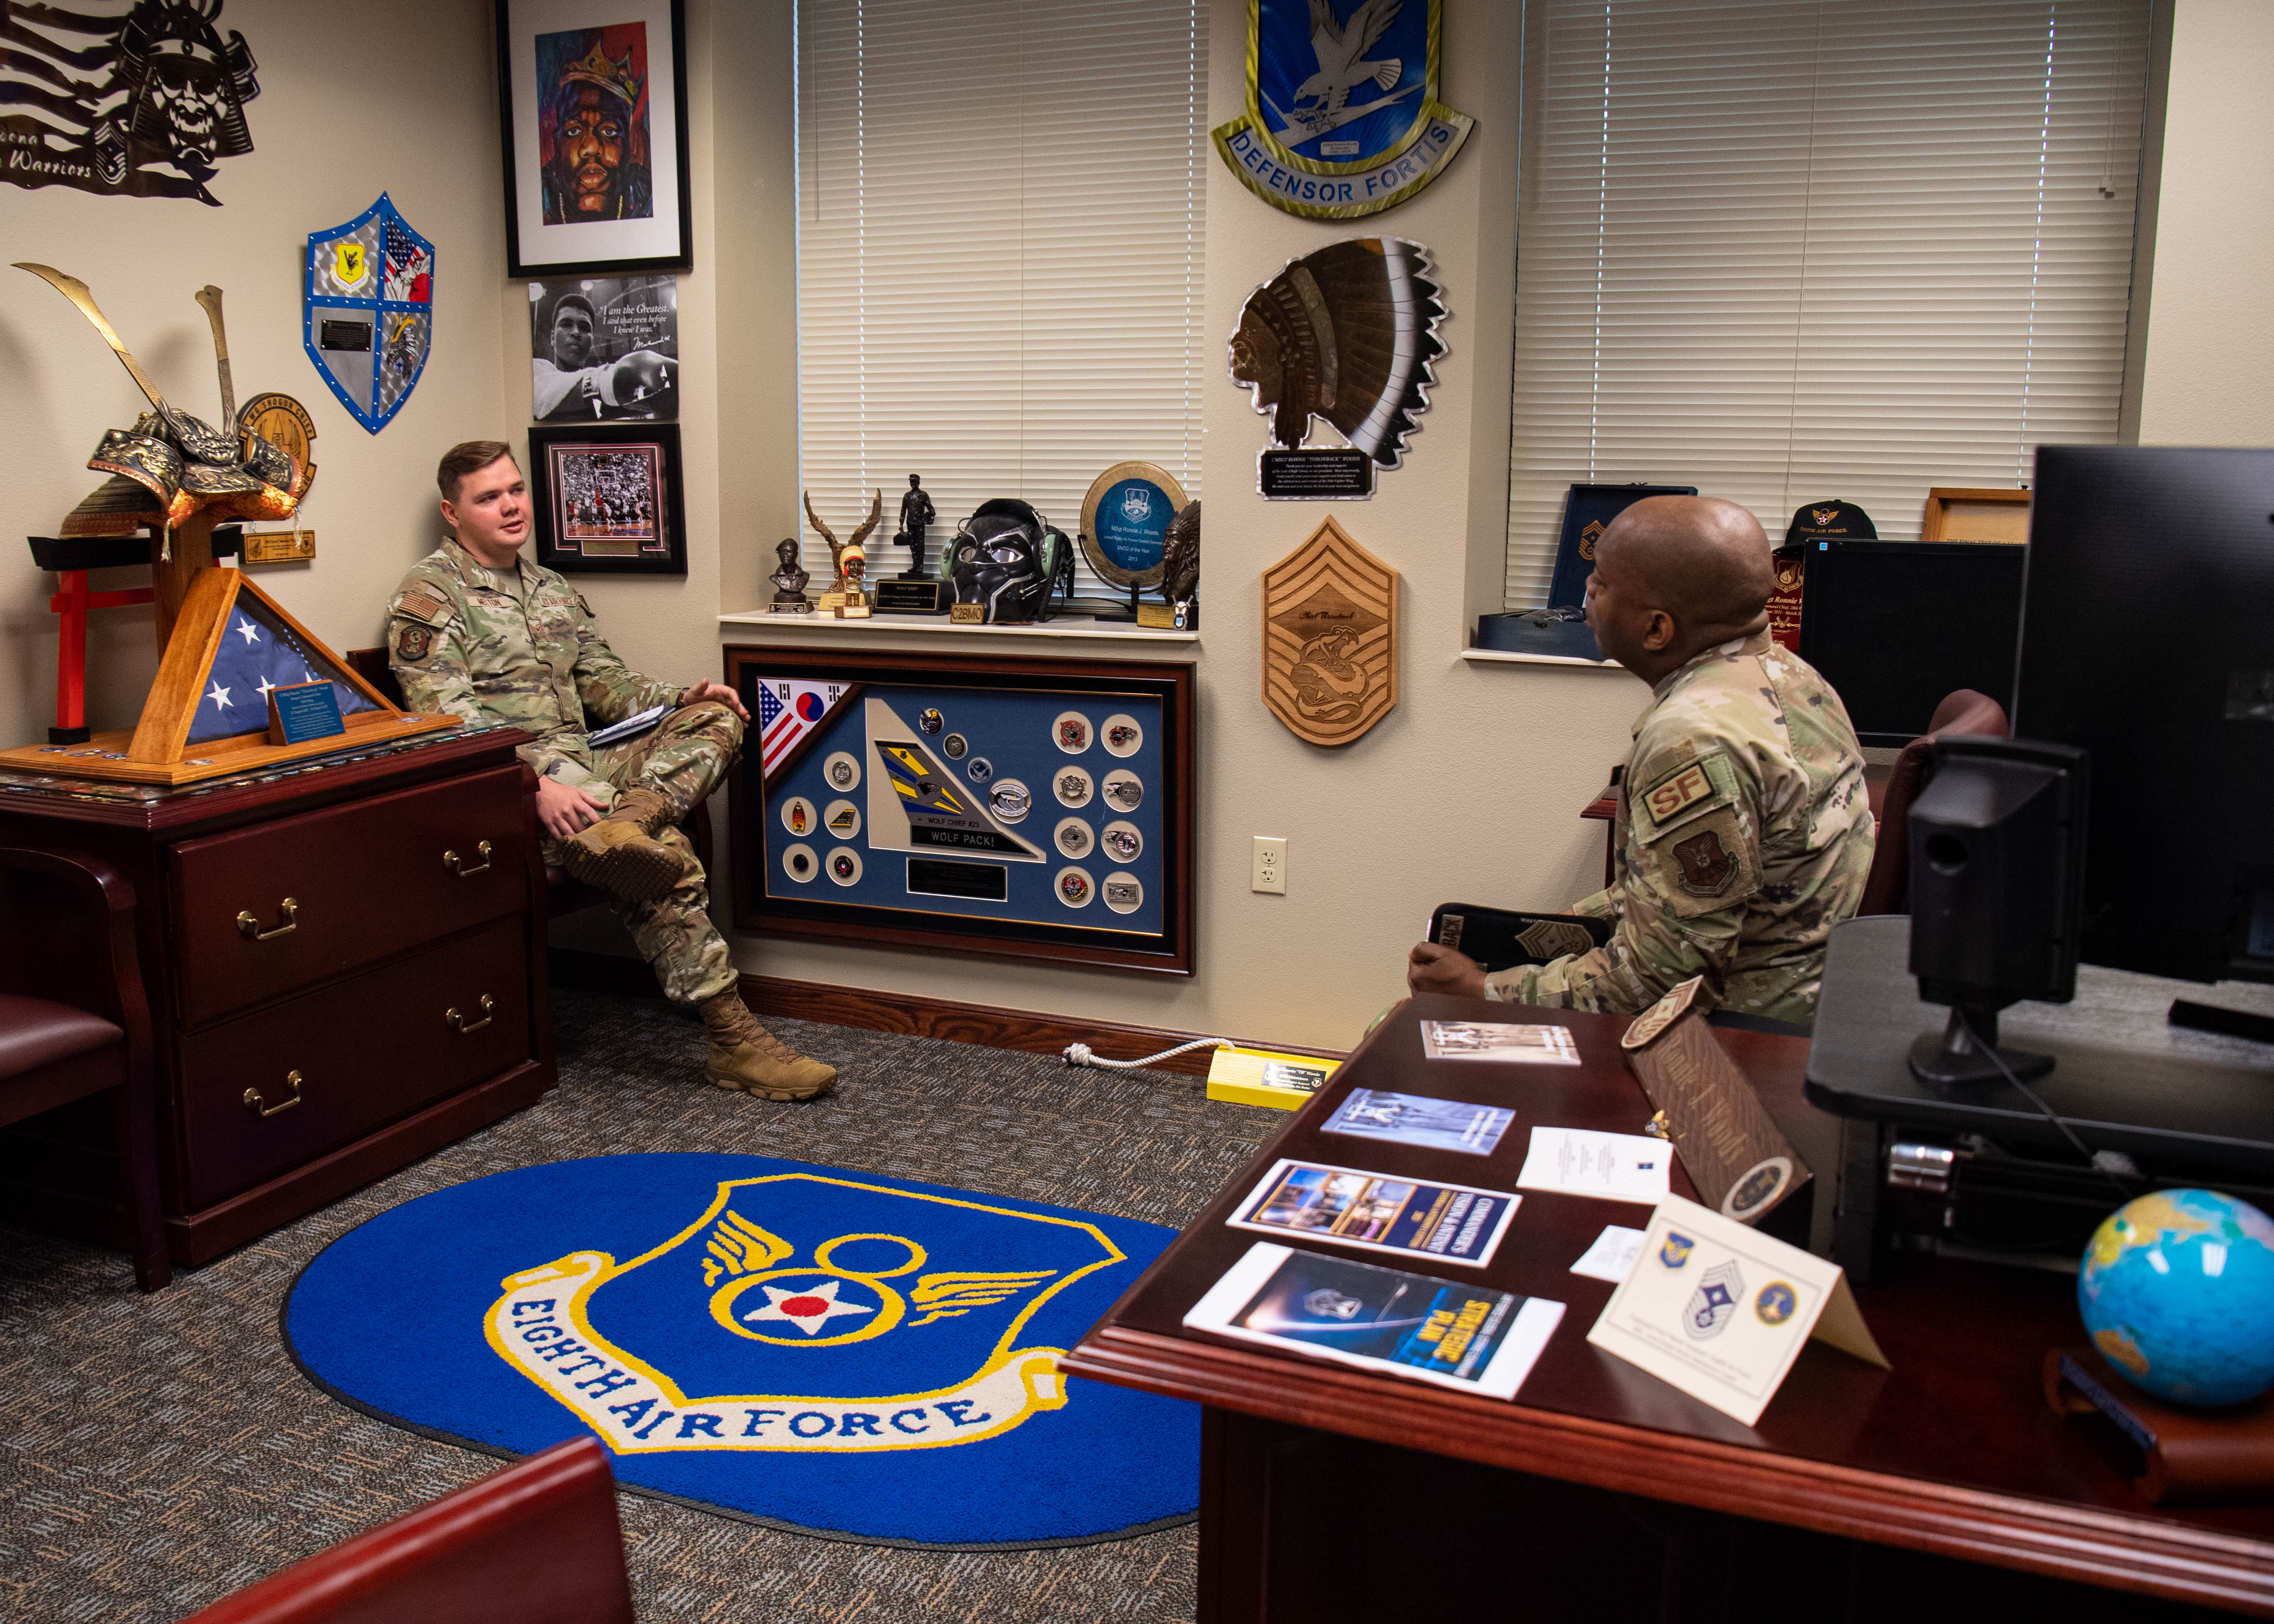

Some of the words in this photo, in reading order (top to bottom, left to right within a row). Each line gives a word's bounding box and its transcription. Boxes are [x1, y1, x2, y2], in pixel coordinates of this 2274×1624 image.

[9, 149, 91, 178] Warriors
[1233, 133, 1353, 202] DEFENSOR
[1365, 125, 1449, 197] FORTIS
[623, 304, 635, 314] the
[637, 303, 669, 314] Greatest.
[649, 315, 667, 324] before
[618, 326, 634, 335] knew
[262, 398, 294, 410] SHOGUN
[295, 409, 313, 434] CHIEF
[477, 598, 501, 606] MELTON
[952, 607, 982, 620] C2BMO
[1652, 770, 1700, 814] SF
[931, 832, 959, 843] WOLF
[963, 834, 994, 847] PACK!
[1417, 1309, 1456, 1343] PLAN
[1432, 1300, 1492, 1363] STRATEGIC
[511, 1299, 637, 1400] EIGHTH
[607, 1398, 726, 1441] AIR
[740, 1399, 991, 1438] FORCE
